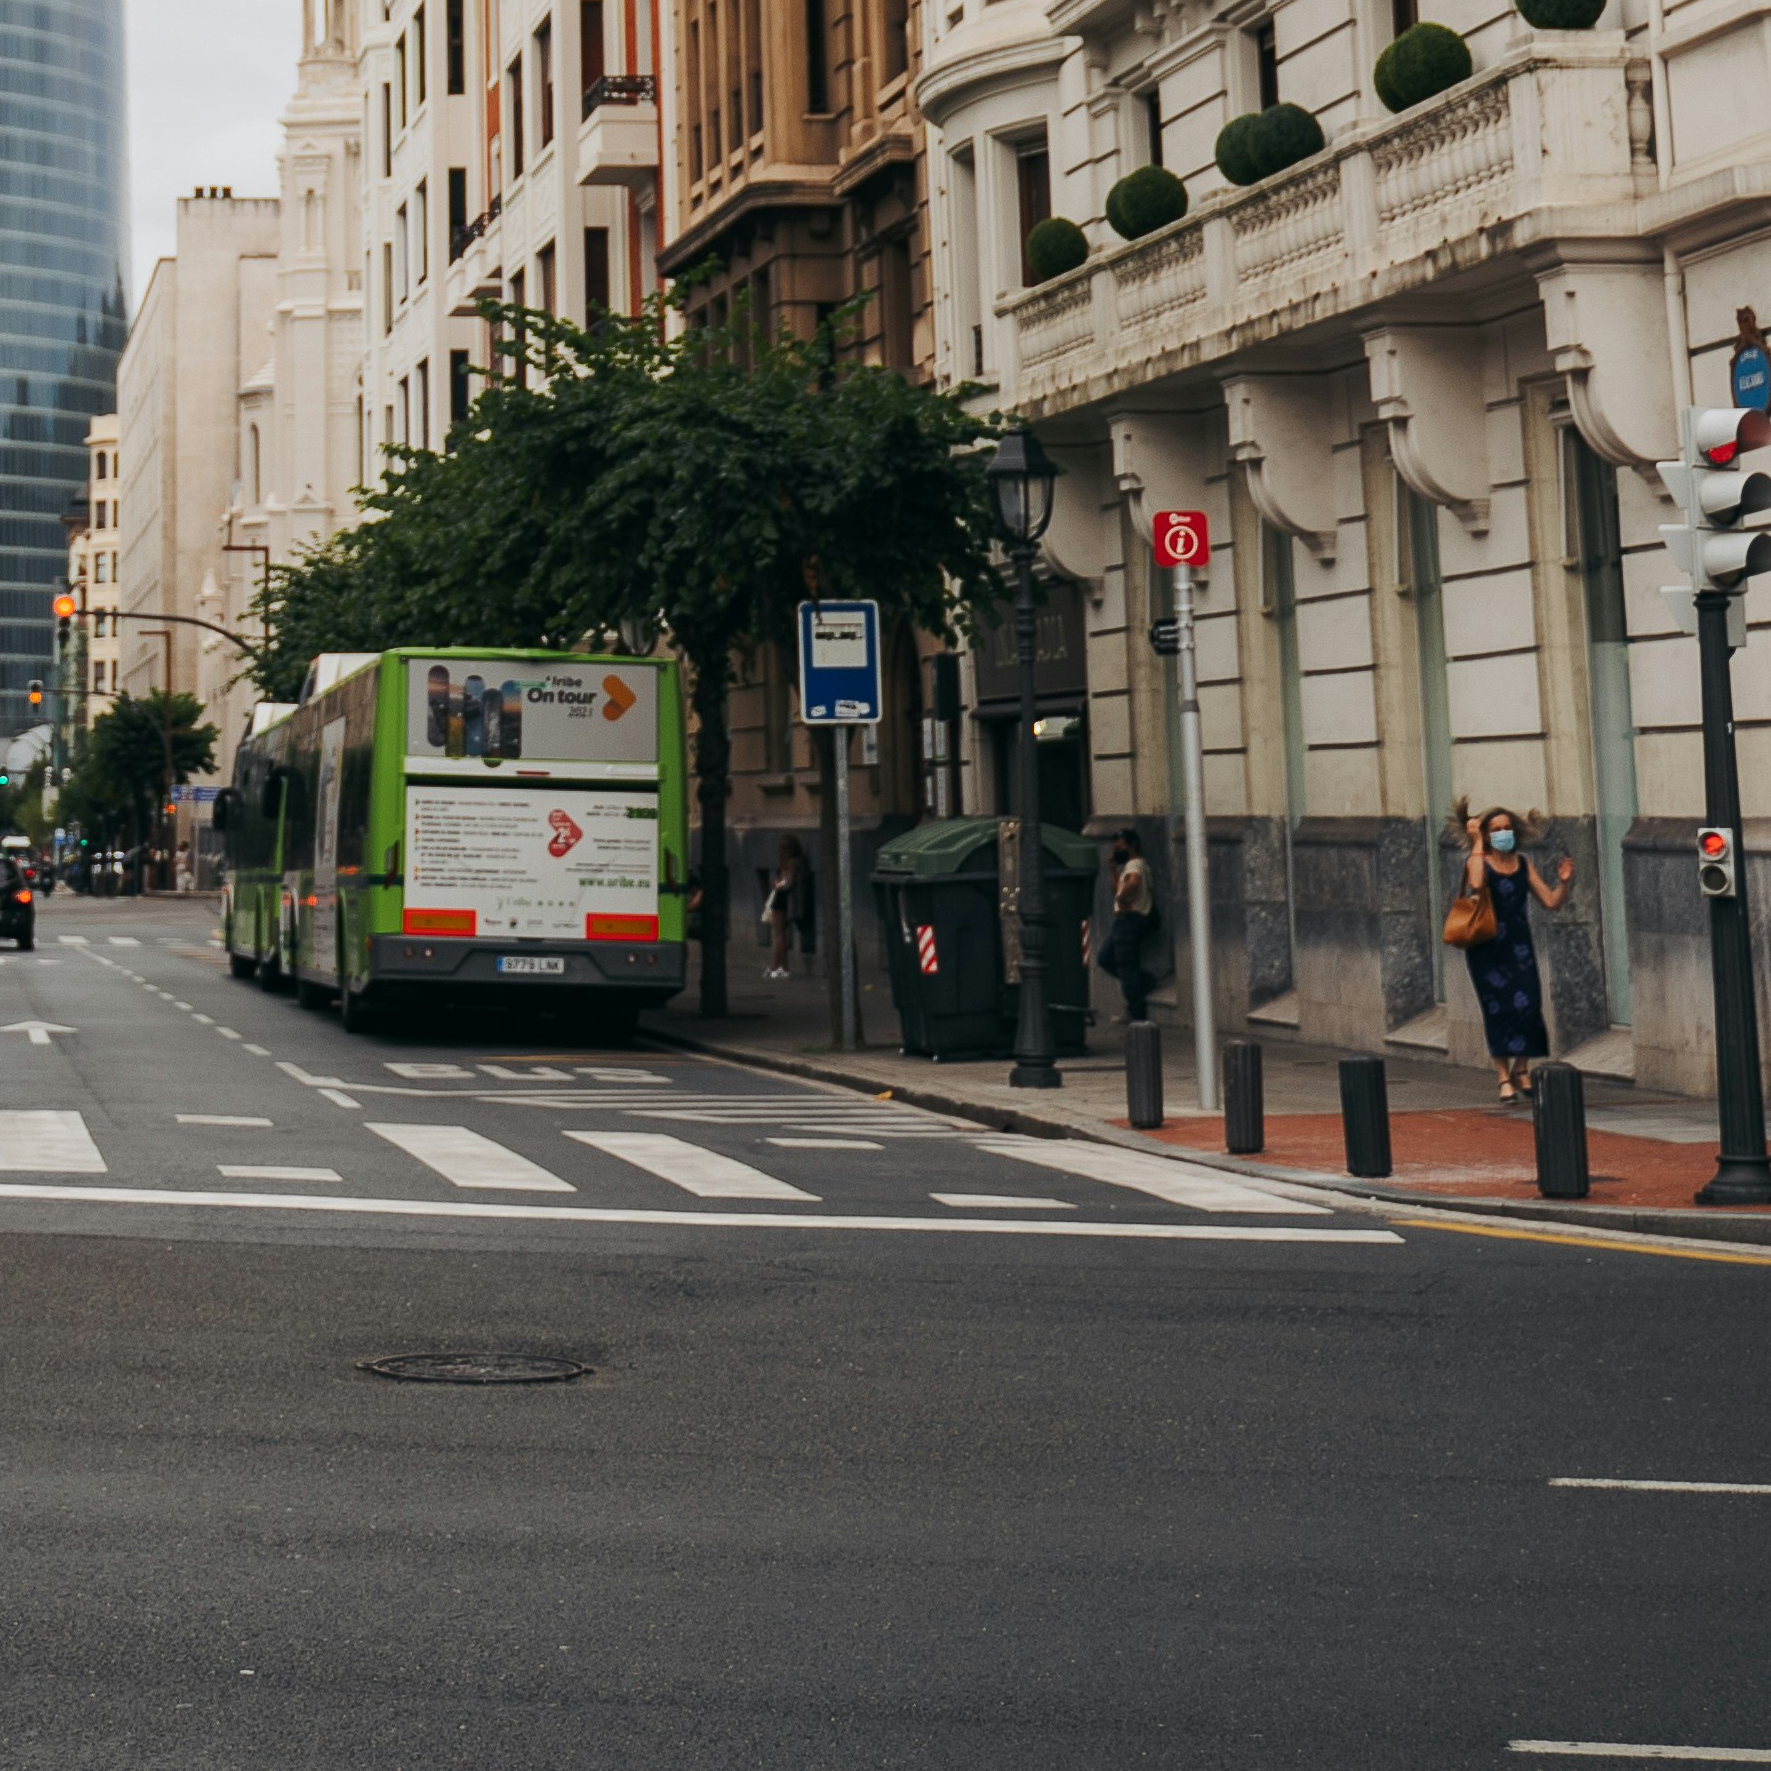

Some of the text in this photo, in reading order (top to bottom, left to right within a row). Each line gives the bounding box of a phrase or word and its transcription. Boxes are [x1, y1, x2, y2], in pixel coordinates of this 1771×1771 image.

[527, 687, 598, 705] On tour
[383, 1062, 674, 1084] BUS
